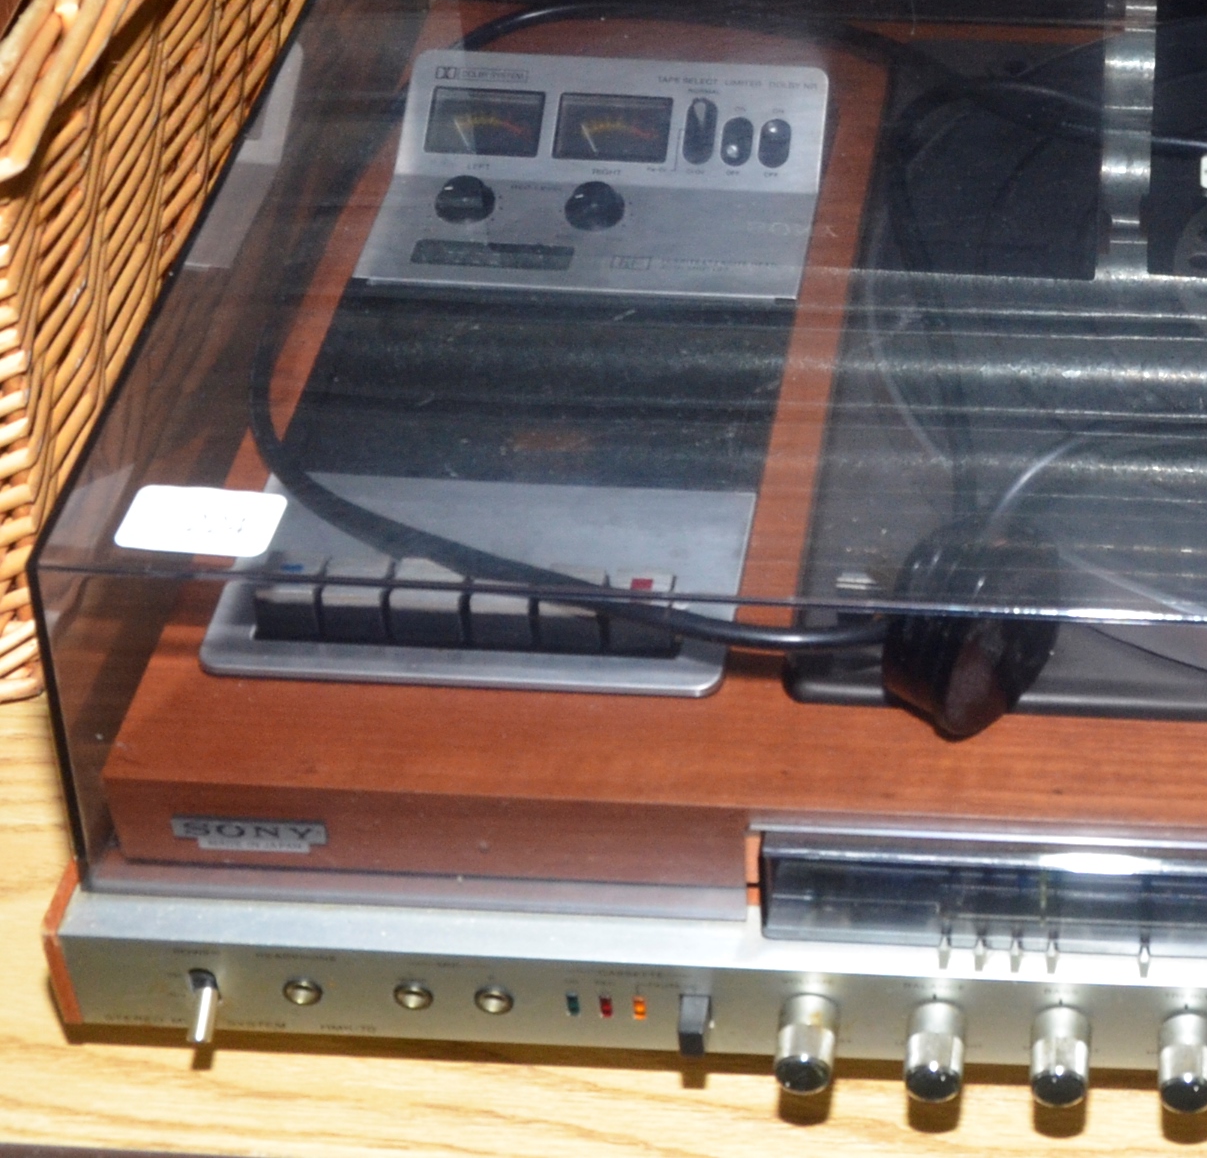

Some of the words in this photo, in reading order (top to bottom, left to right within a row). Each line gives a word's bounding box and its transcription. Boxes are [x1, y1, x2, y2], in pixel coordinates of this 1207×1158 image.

[658, 75, 679, 84] TAPE
[682, 77, 718, 85] SELECT
[724, 79, 762, 87] LIMITER
[768, 81, 800, 89] DOLBY
[466, 162, 490, 170] LEFT
[591, 168, 622, 176] RIGHT
[183, 821, 313, 839] SONY
